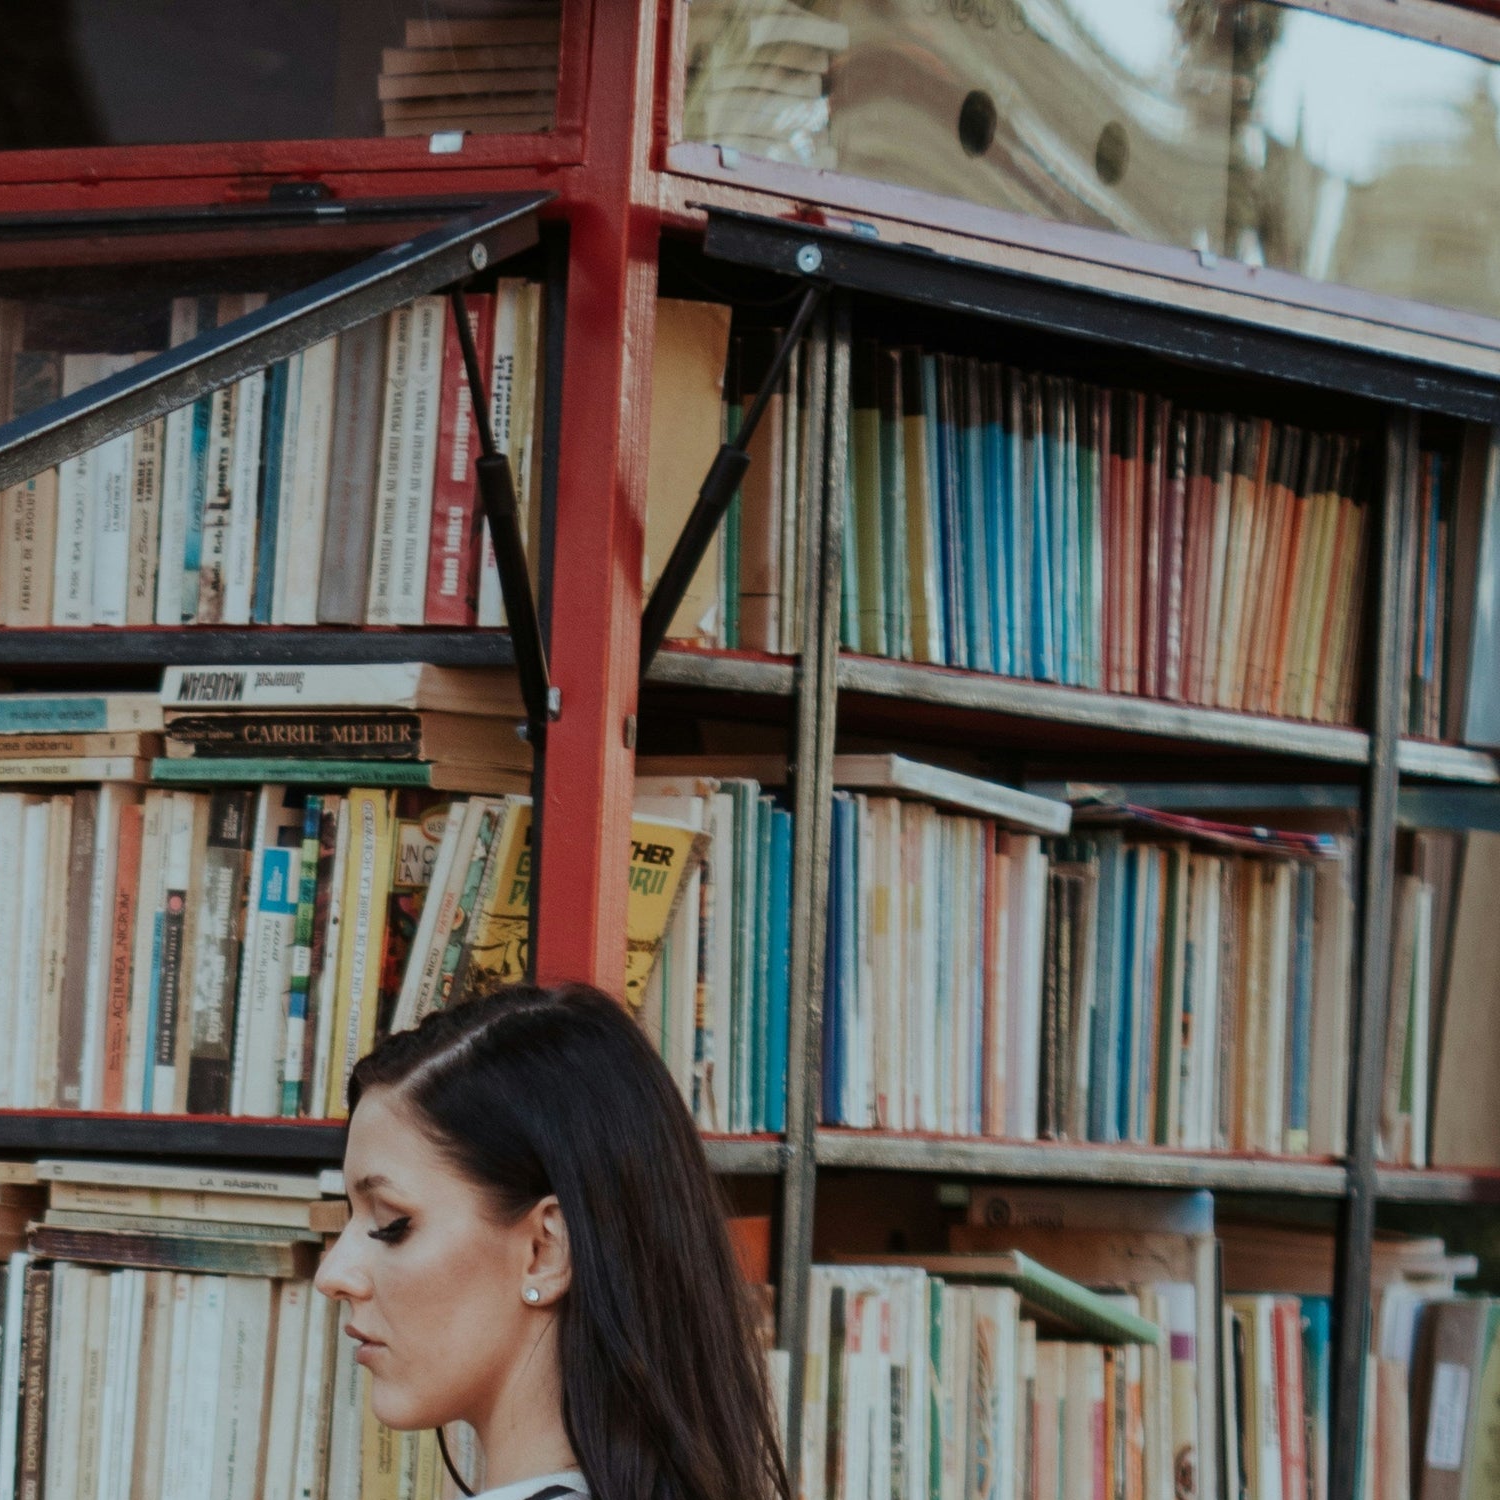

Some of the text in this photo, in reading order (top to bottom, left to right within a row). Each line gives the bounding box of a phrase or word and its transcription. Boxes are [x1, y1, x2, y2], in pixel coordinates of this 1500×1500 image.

[389, 392, 403, 432] PICKWICK
[414, 390, 428, 430] PICKWICK
[387, 437, 400, 475] CLUBULUI
[387, 479, 397, 492] ALE
[410, 477, 420, 491] ALE
[383, 498, 395, 535] POSTUME
[407, 497, 419, 534] POSTUME
[21, 492, 36, 610] FABRICA DE ABSOLUT
[377, 539, 392, 596] DOCUMENTELE
[402, 539, 416, 596] DOCUMENTELE
[179, 672, 246, 700] MAUGHAM
[26, 740, 72, 750] ciobanu
[244, 724, 320, 743] CARRIE
[330, 724, 411, 743] MEEBER
[32, 764, 69, 774] mistral
[360, 877, 371, 889] LA
[271, 920, 281, 961] proze
[355, 934, 366, 946] DE
[352, 951, 364, 974] CAZ
[426, 948, 440, 978] MICU
[112, 955, 127, 1019] ACȚIUNEA
[351, 978, 362, 996] UN
[346, 1010, 359, 1066] REBREANU
[200, 1178, 214, 1187] LA
[29, 1283, 46, 1359] NASTASIA
